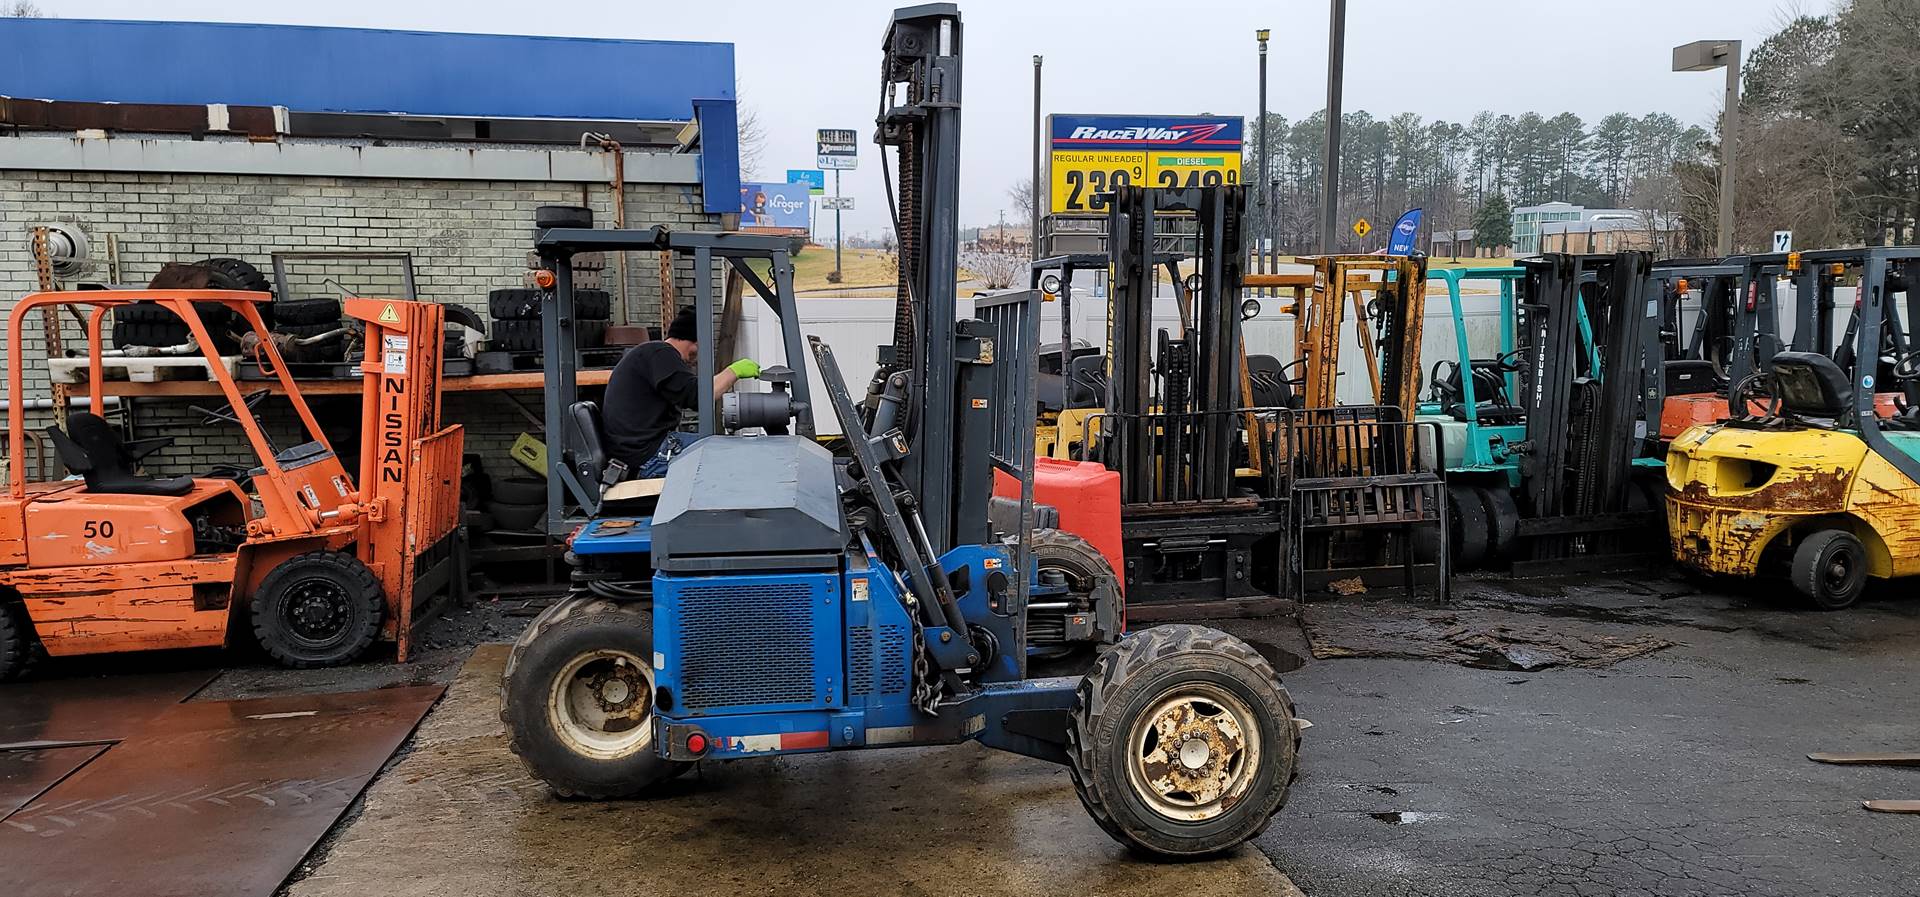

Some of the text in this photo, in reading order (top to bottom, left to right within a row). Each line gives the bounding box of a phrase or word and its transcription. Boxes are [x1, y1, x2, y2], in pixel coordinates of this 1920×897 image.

[1070, 126, 1188, 140] RACEWAY
[1098, 155, 1143, 163] UNLEADED
[1133, 166, 1142, 179] 9
[769, 194, 804, 214] Kroger
[1106, 261, 1115, 378] HYSTER
[1536, 329, 1547, 408] MITSUBISHI
[383, 377, 405, 483] NISSAN
[84, 521, 114, 538] 50
